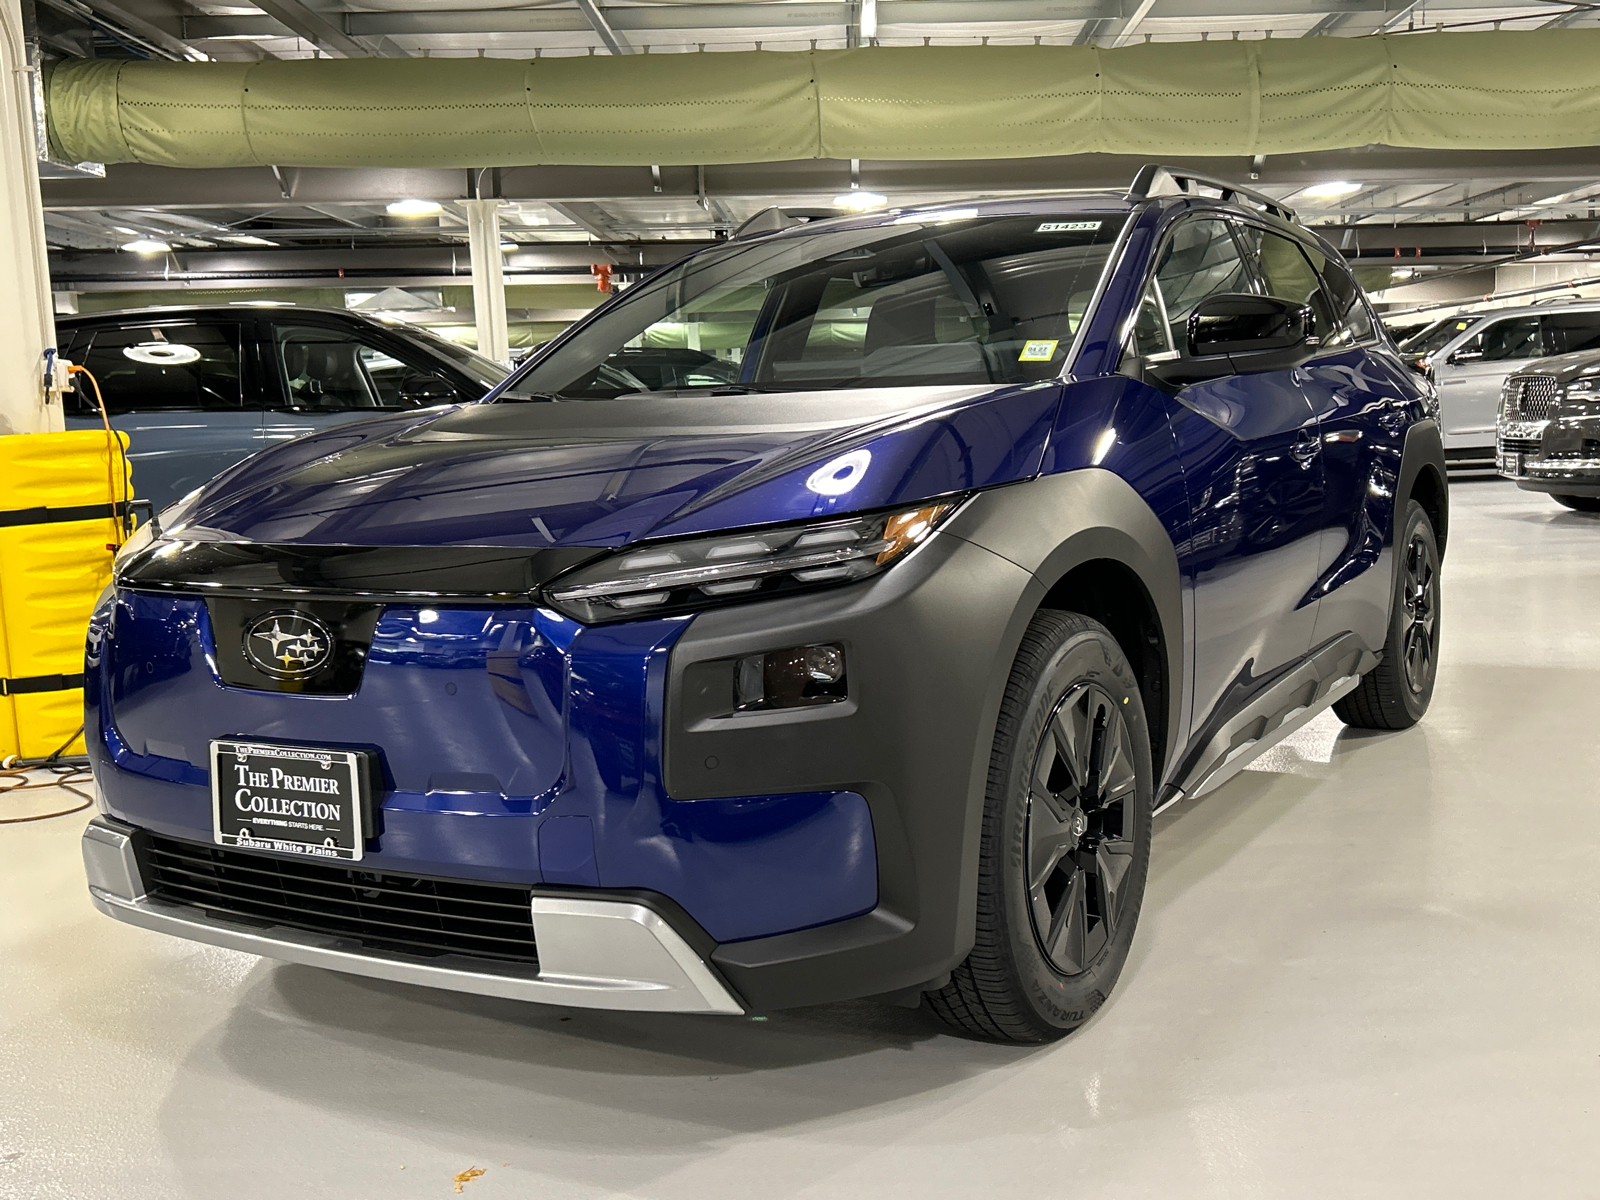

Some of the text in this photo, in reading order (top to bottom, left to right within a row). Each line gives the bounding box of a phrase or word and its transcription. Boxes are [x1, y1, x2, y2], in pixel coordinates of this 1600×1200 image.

[1041, 222, 1097, 231] S14233
[234, 764, 340, 795] THE PREMIER
[1010, 680, 1055, 868] BRIDGESTONE
[234, 788, 341, 821] COLLECTION
[252, 817, 288, 827] EVERYTHING
[288, 820, 308, 830] STARTS
[236, 837, 338, 857] Subaru White Plains
[1031, 979, 1085, 1021] TURANZA
